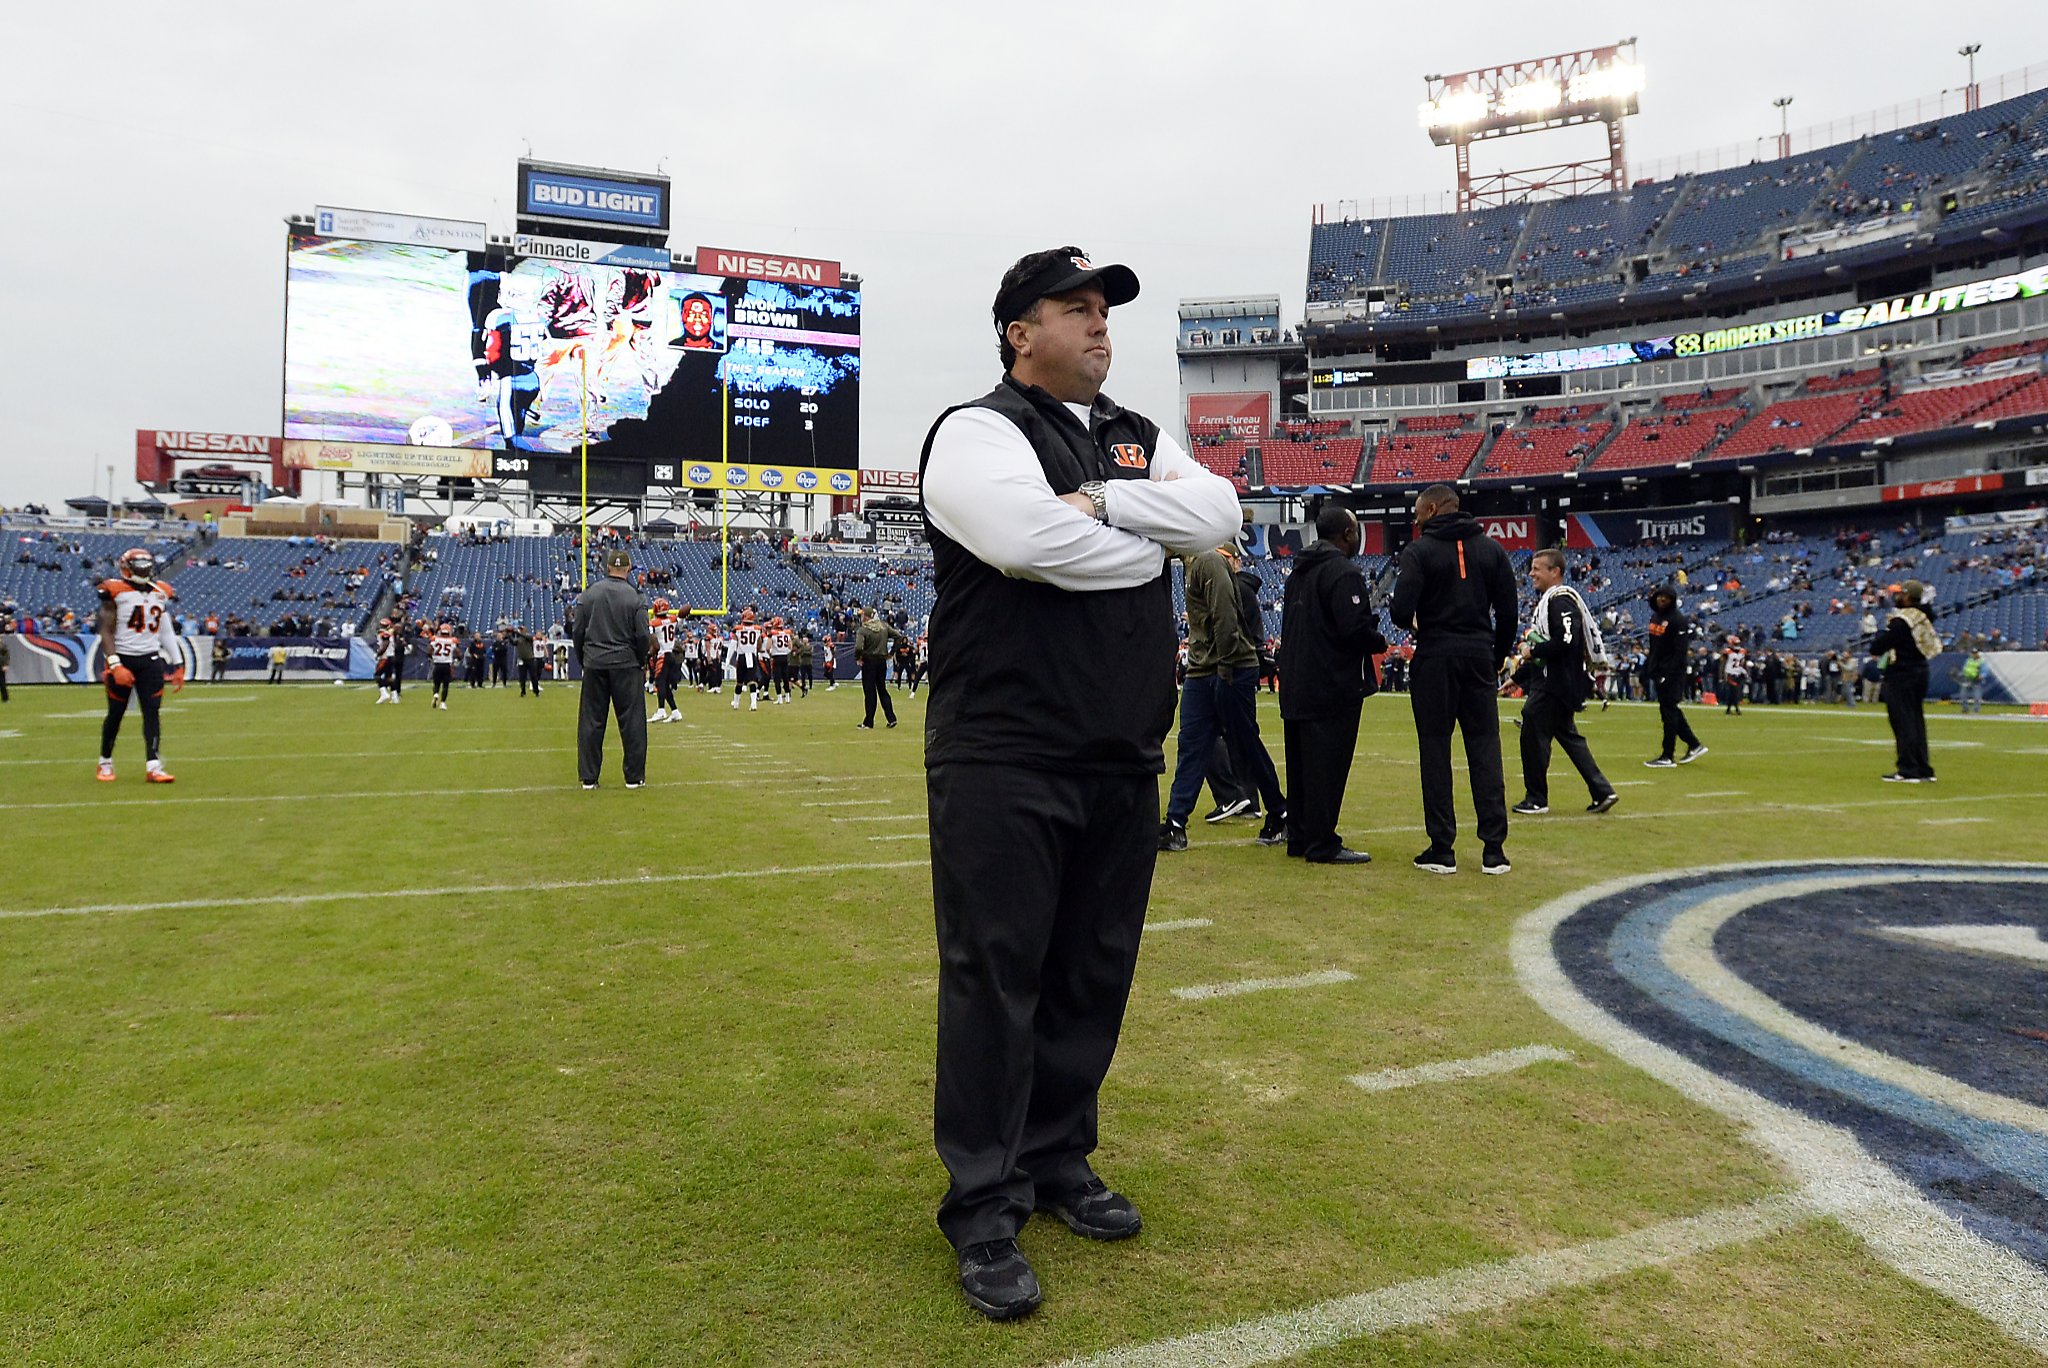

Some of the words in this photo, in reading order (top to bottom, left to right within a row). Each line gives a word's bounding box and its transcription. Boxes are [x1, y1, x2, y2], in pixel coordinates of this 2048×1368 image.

[534, 184, 585, 206] BUD
[586, 190, 654, 213] LIGHT
[517, 237, 590, 259] Pinnacle
[718, 254, 821, 281] NISSAN
[734, 298, 776, 312] JAYON
[1837, 275, 2019, 330] SALUTES
[734, 309, 798, 327] BROWN
[1703, 323, 1771, 352] COOPER
[1774, 313, 1824, 340] STEEL
[756, 365, 805, 378] SEASON
[1314, 374, 1333, 383] 11:25
[734, 398, 770, 410] SOLO
[800, 402, 818, 414] 20
[734, 415, 770, 428] PDEF
[1199, 416, 1224, 424] Farm
[1226, 415, 1260, 424] Bureau
[156, 431, 269, 453] NISSAN
[689, 466, 711, 484] Kroger
[726, 468, 747, 485] Kroger
[761, 470, 783, 486] Kroger
[796, 472, 817, 488] Kroger
[831, 474, 852, 490] Kroger
[863, 470, 919, 486] NISS
[195, 483, 242, 494] TITA
[883, 513, 923, 522] TITA
[1637, 515, 1706, 539] TITANS
[127, 605, 162, 634] 43
[661, 625, 675, 643] 16
[740, 631, 757, 645] 50
[776, 635, 789, 648] 59
[434, 643, 451, 657] 25
